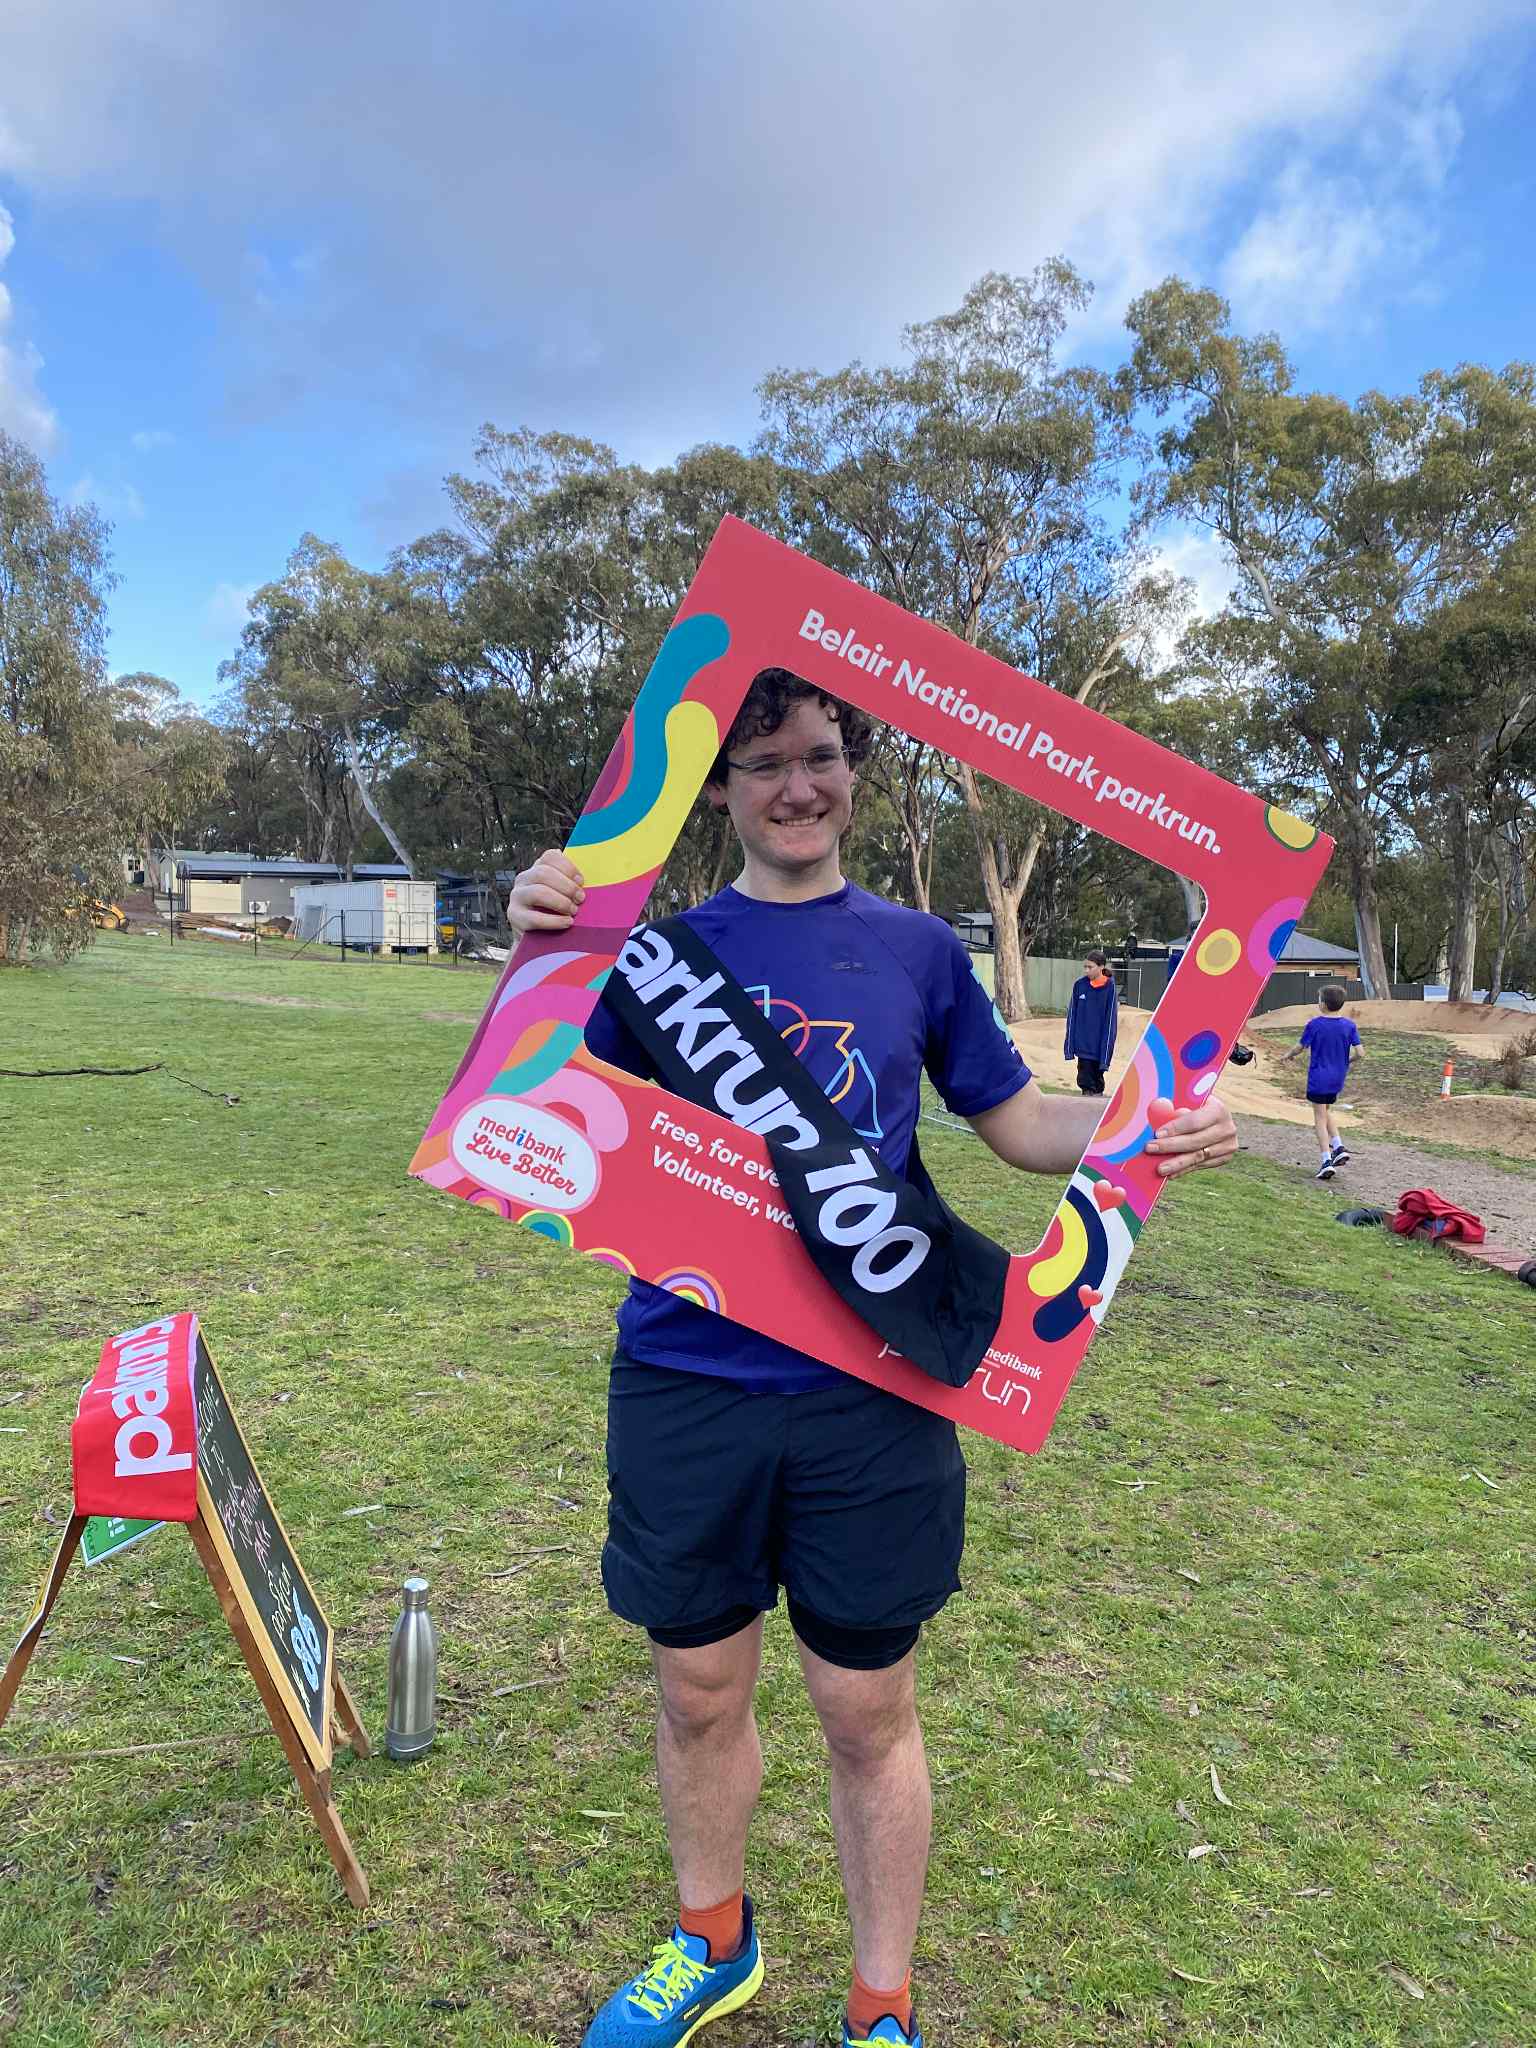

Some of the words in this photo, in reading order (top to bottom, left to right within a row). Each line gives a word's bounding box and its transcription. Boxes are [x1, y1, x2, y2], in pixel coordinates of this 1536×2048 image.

[799, 608, 893, 679] Belair
[892, 658, 1032, 752] National
[1027, 731, 1100, 790] Park
[1095, 774, 1223, 855] parkrun.
[478, 1116, 567, 1166] medibank
[615, 923, 820, 1151] arkrun
[805, 1148, 932, 1293] 100
[650, 1110, 704, 1155] Free,
[708, 1138, 743, 1167] for
[466, 1132, 512, 1165] Live
[512, 1154, 577, 1196] Better
[653, 1145, 760, 1216] Volunteer,
